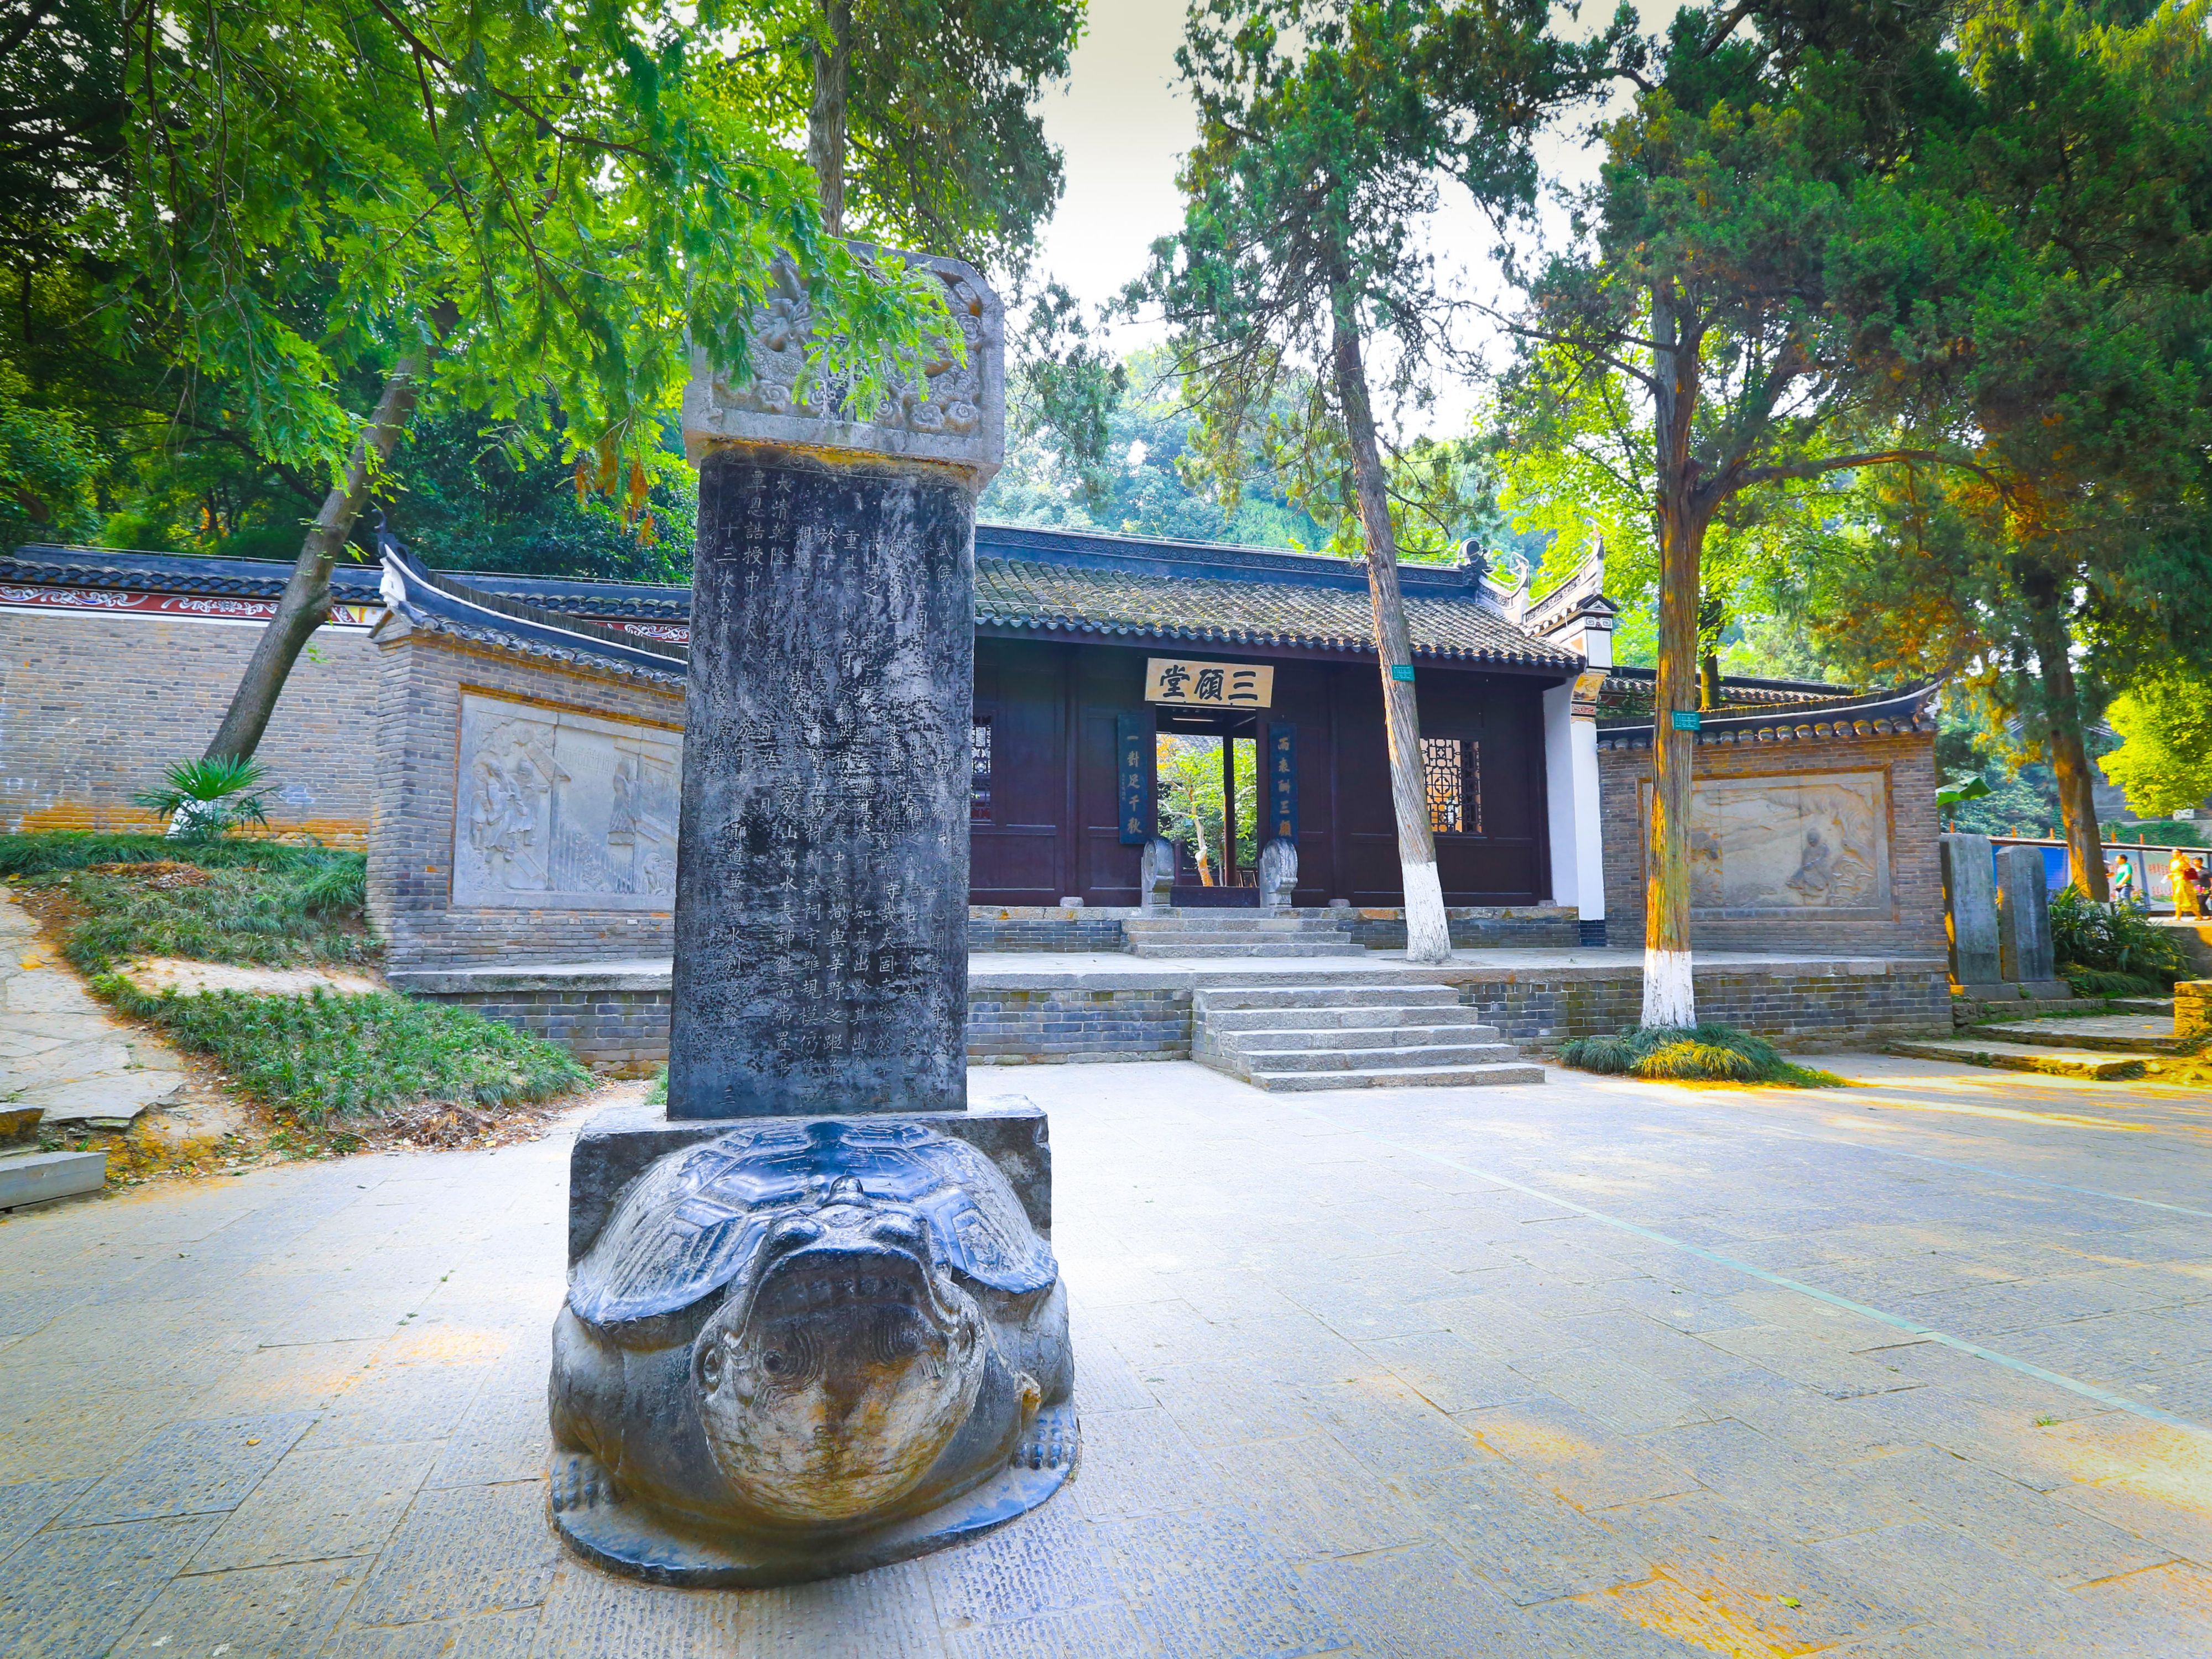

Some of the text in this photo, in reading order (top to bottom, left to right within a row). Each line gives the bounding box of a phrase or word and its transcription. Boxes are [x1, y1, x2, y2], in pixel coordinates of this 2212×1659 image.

[1160, 665, 1258, 701] 三顧堂
[1126, 735, 1142, 834] 一對足千秋
